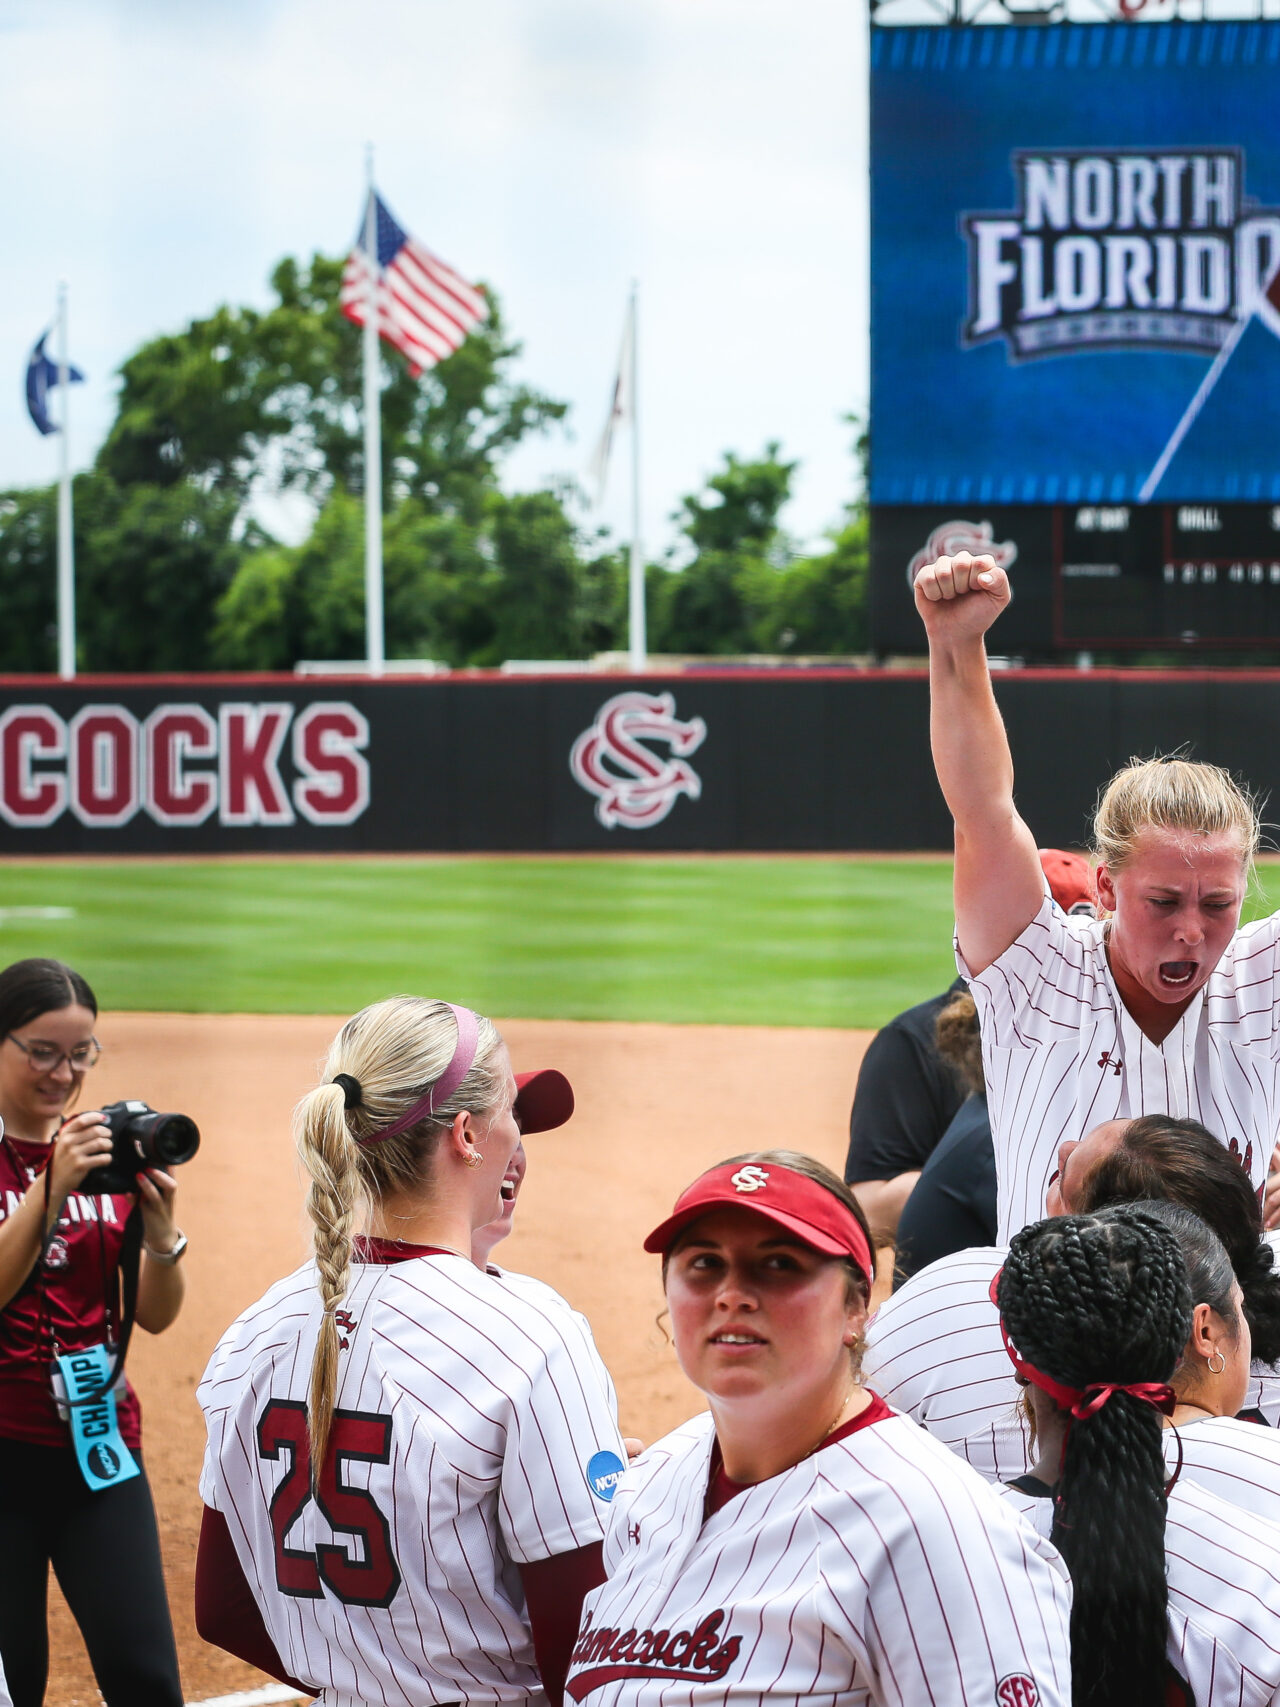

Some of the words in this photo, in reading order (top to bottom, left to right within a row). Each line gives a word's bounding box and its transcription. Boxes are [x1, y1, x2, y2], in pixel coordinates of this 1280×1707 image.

[1024, 155, 1235, 230] NORTH
[0, 702, 371, 828] COCKS
[257, 1398, 401, 1609] 25
[999, 1676, 1036, 1707] SEC
